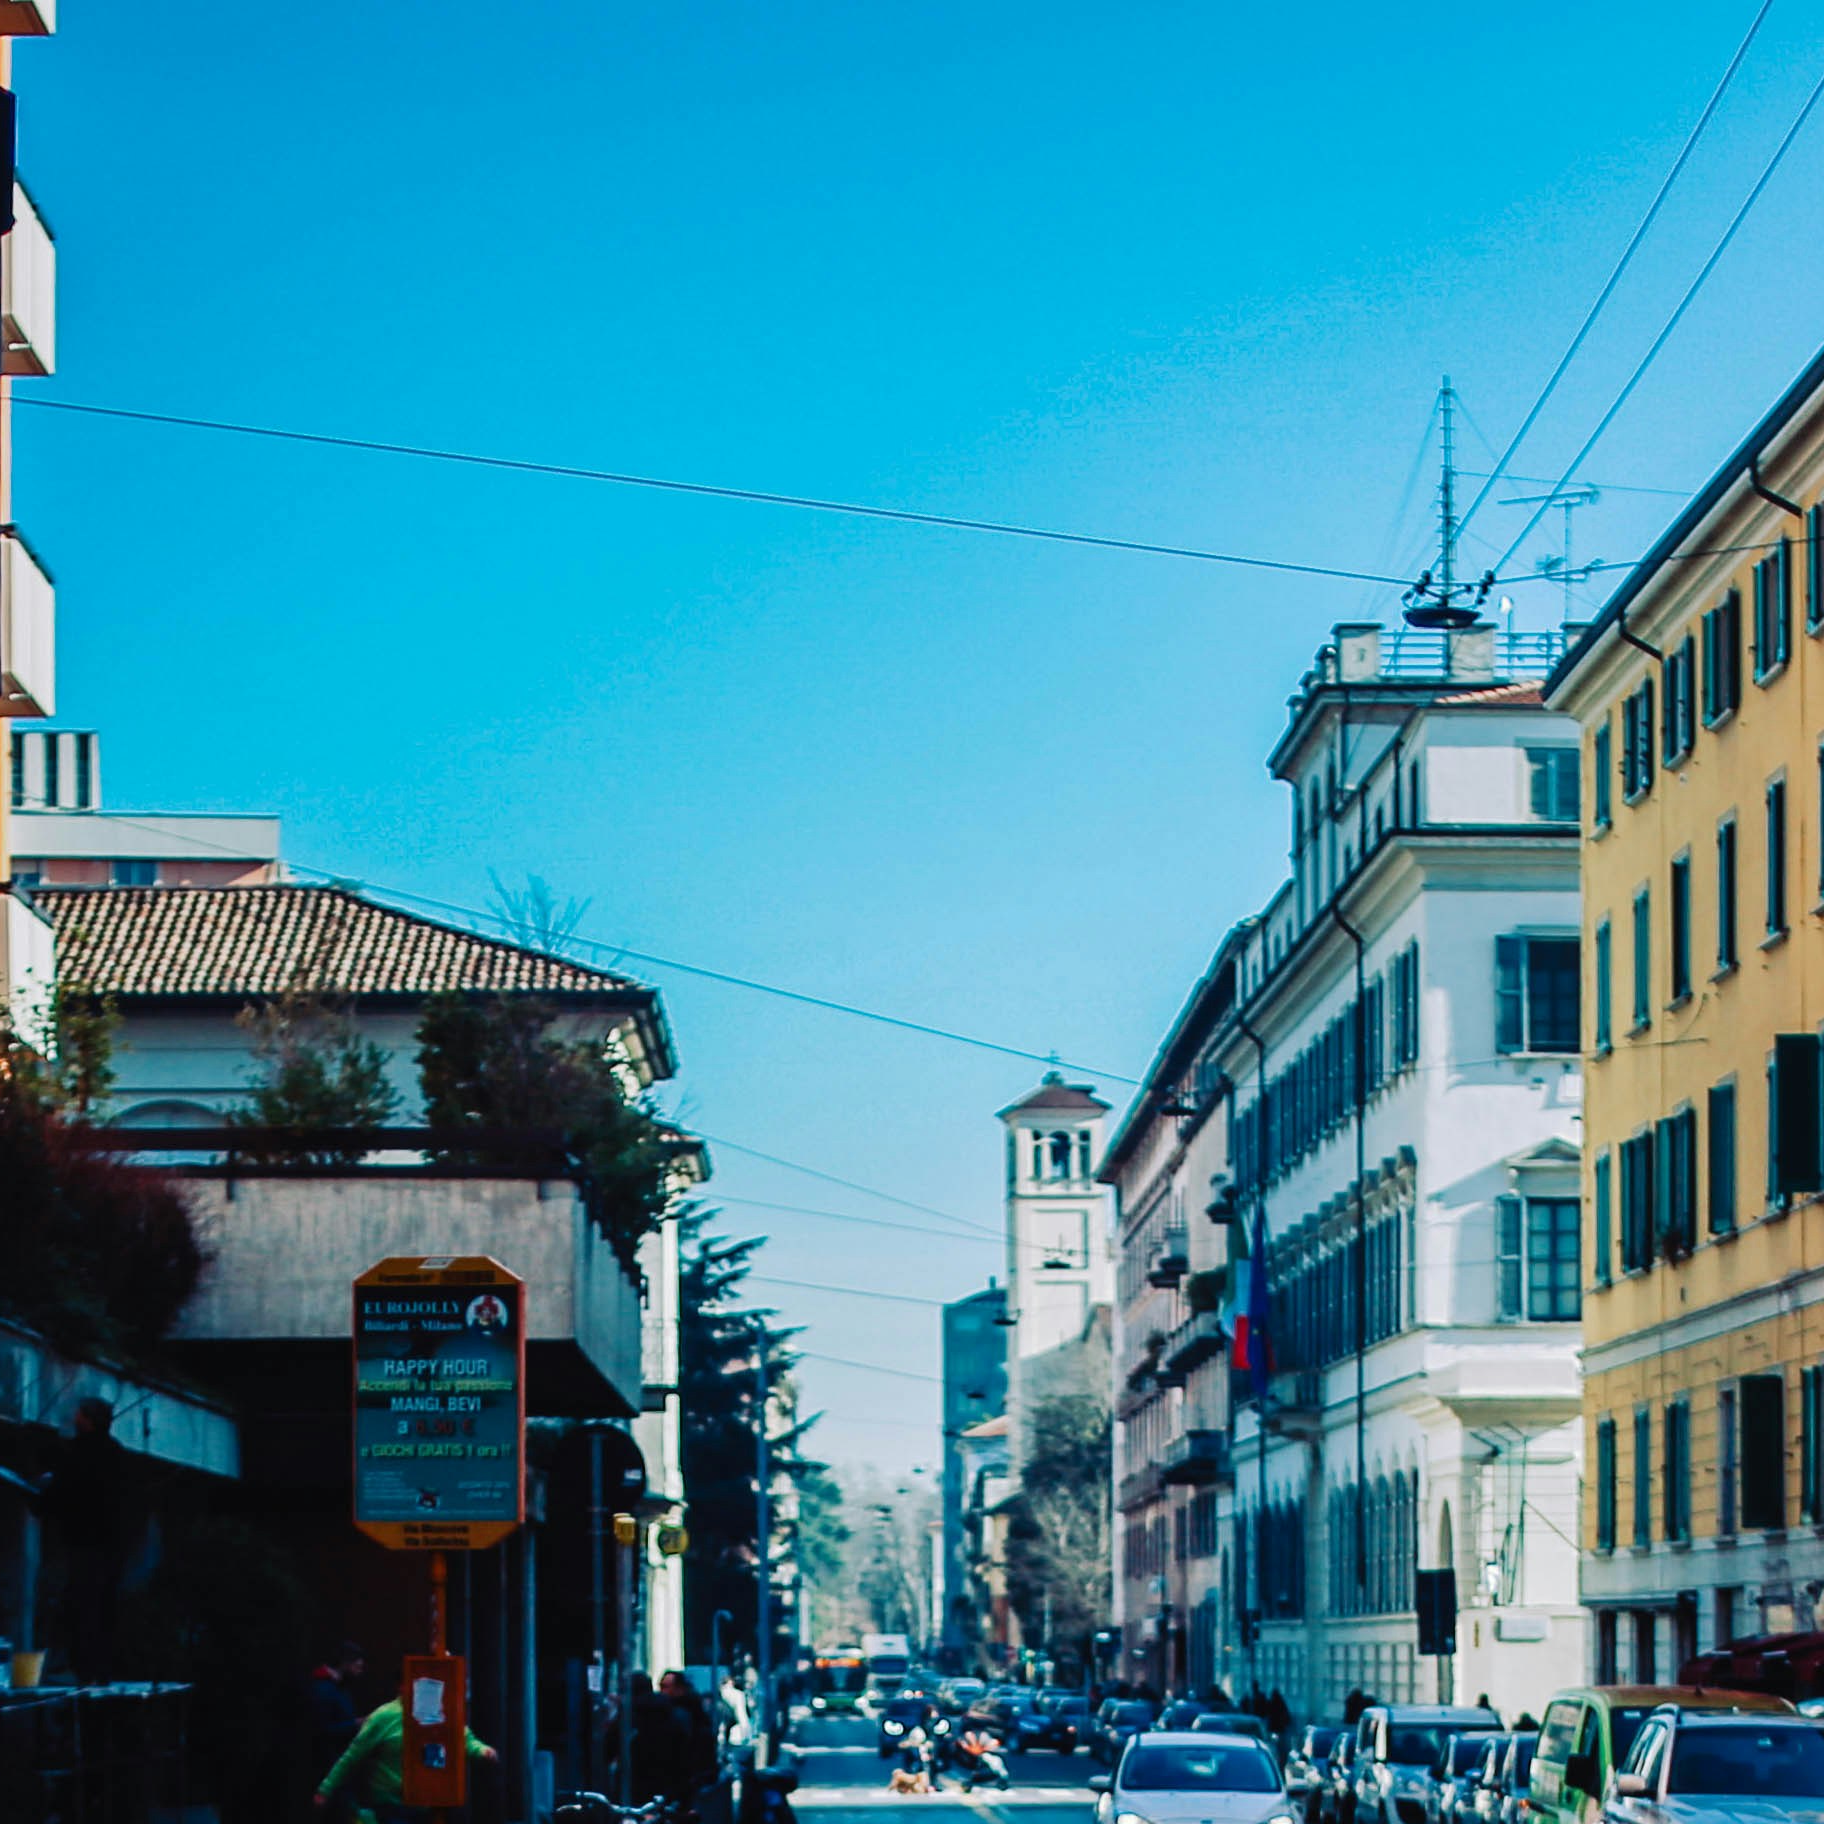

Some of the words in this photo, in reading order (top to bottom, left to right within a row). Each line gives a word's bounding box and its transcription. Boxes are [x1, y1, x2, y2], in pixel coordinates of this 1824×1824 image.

[363, 1300, 461, 1315] EUROJOLLY
[383, 1359, 439, 1376] HAPPY
[442, 1359, 489, 1376] HOUR
[390, 1396, 445, 1413] MANGI,
[447, 1396, 482, 1412] BEVI
[397, 1420, 409, 1435] a
[372, 1444, 416, 1457] GIOCHI
[418, 1444, 466, 1457] GRATIS
